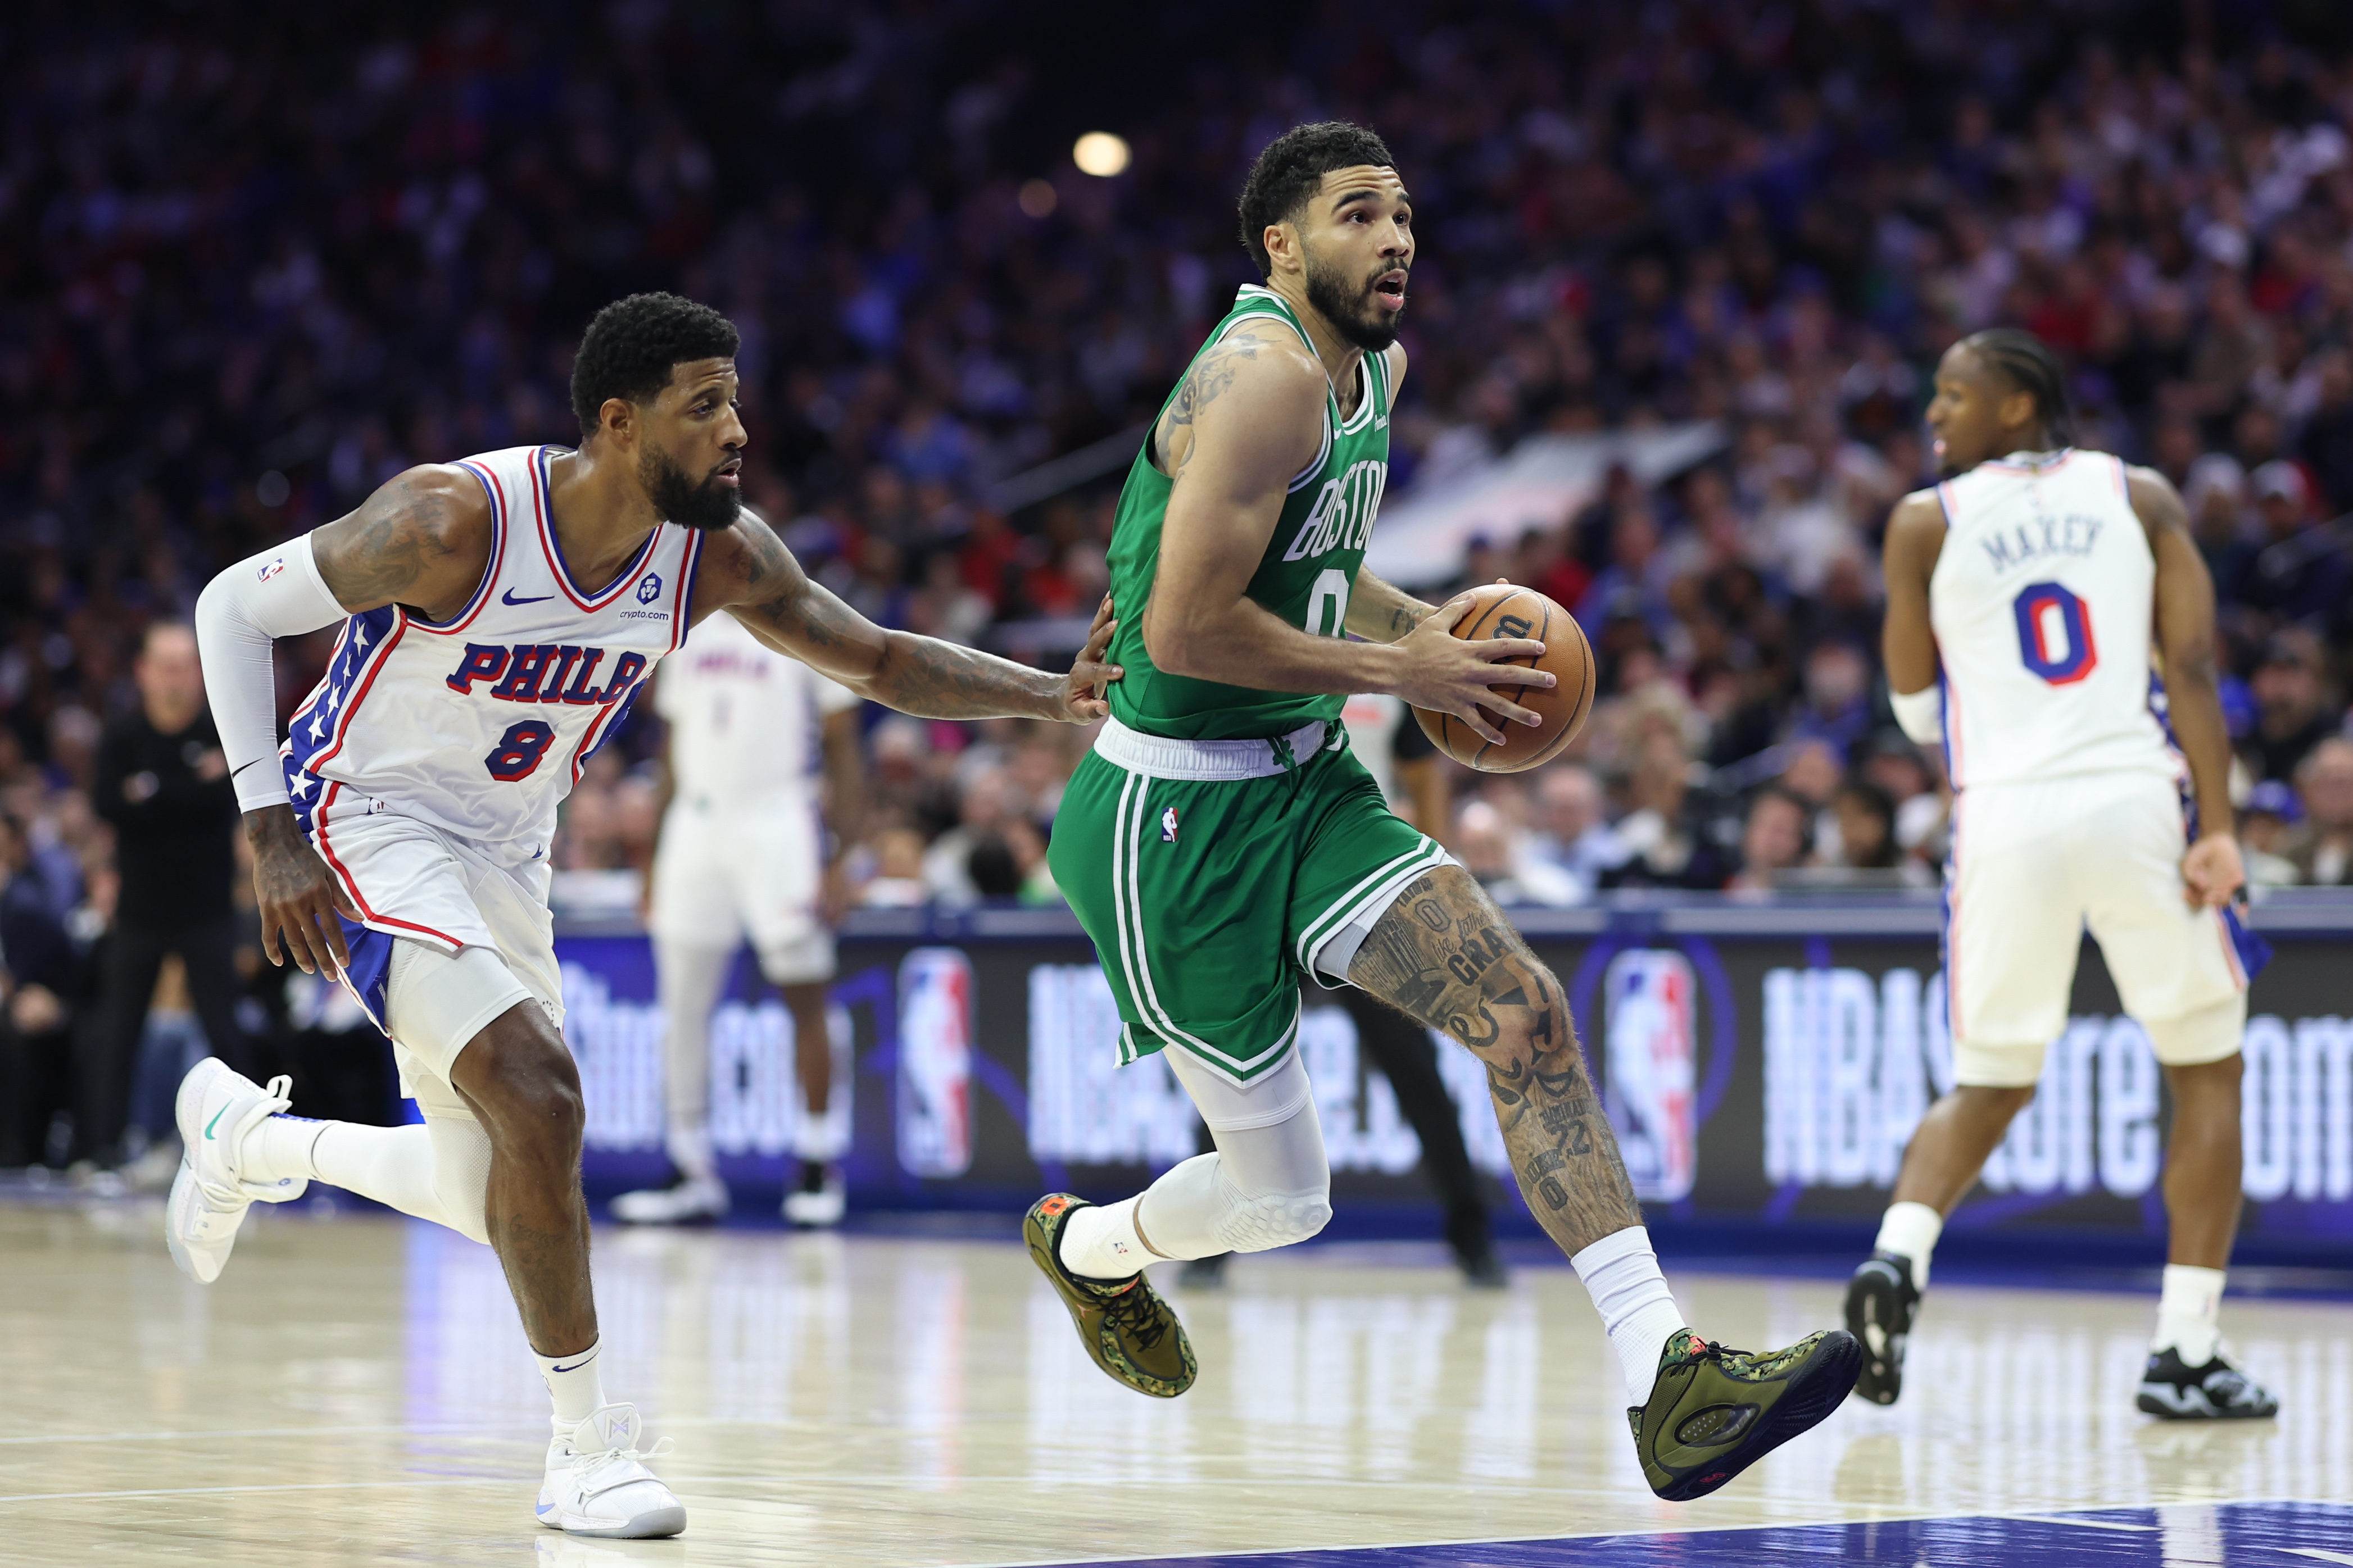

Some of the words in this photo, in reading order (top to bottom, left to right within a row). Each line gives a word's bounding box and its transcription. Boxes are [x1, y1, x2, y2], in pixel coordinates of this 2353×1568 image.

[1979, 513, 2104, 574] MAXEY
[619, 610, 669, 620] crypto.com
[1304, 569, 1349, 638] 0
[2013, 581, 2099, 688] 0
[484, 720, 556, 782] 8
